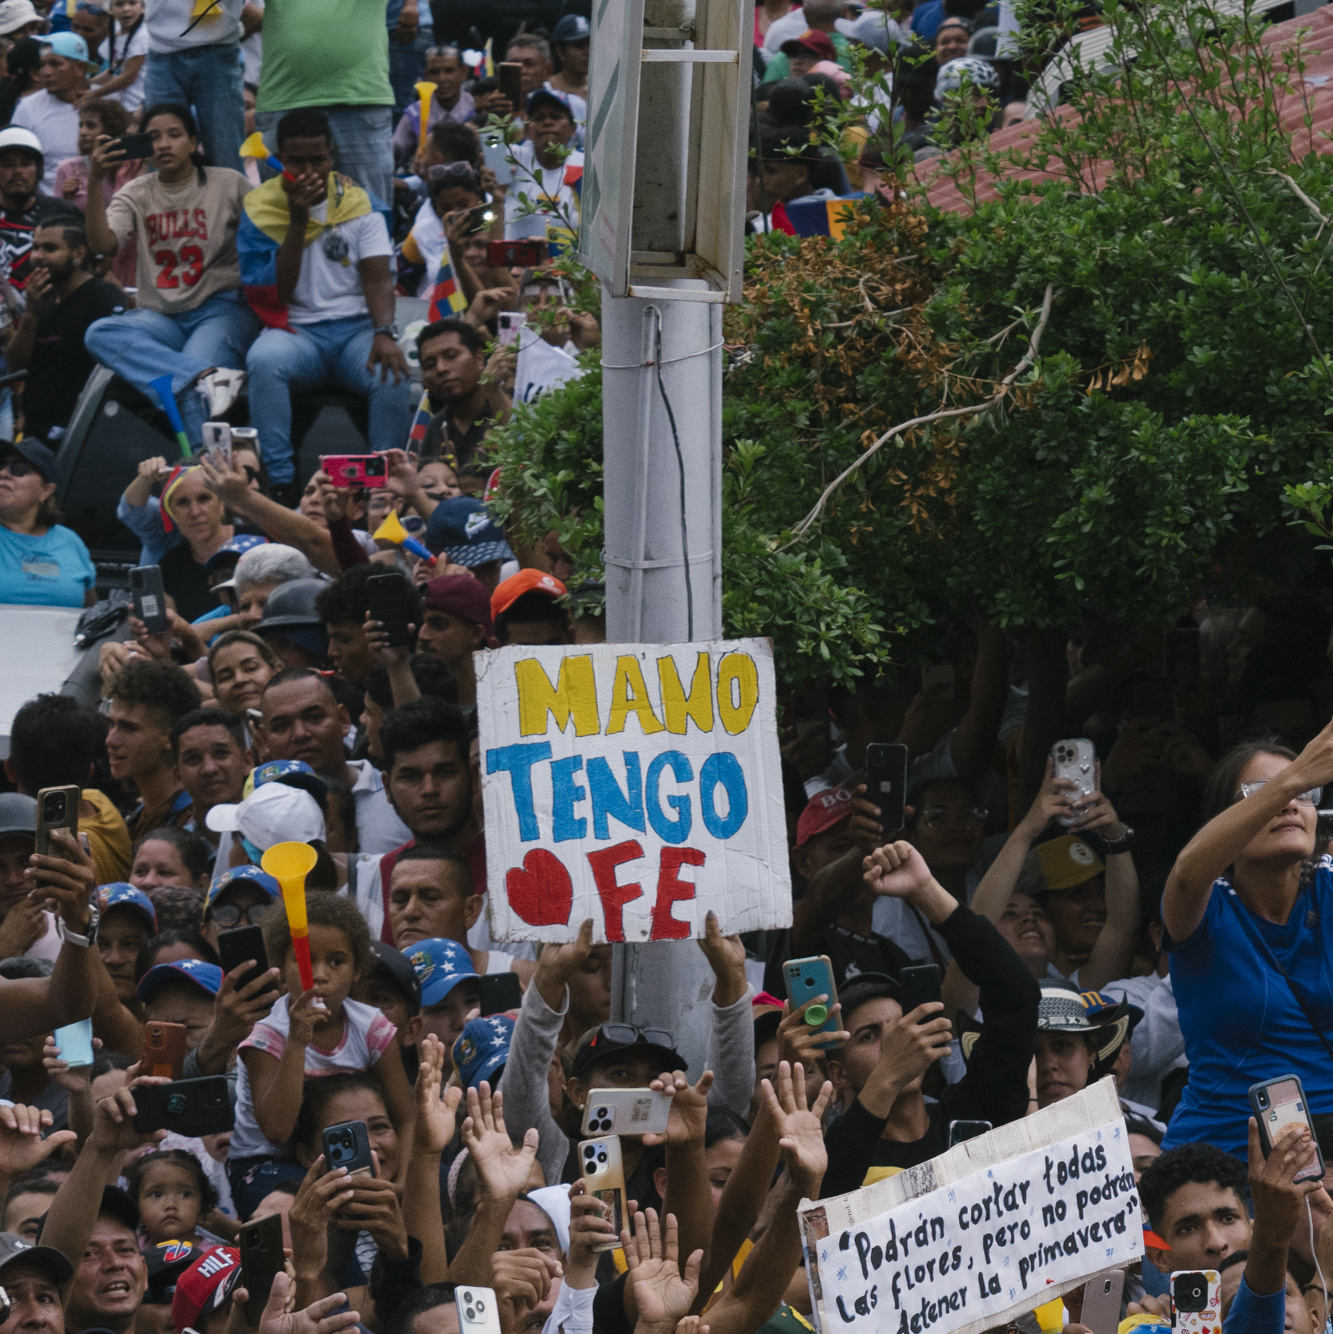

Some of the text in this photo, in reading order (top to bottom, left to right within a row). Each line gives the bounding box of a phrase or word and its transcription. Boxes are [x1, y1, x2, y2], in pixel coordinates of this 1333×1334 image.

[146, 209, 207, 247] BULLS
[155, 244, 203, 288] 23
[515, 652, 759, 737] MANO
[486, 741, 749, 843] TENGO
[586, 839, 706, 942] FE
[958, 1177, 1031, 1231] cortar
[1043, 1143, 1107, 1194] todas
[982, 1219, 1032, 1265] pero
[1042, 1196, 1068, 1228] no
[1076, 1168, 1136, 1219] podrán
